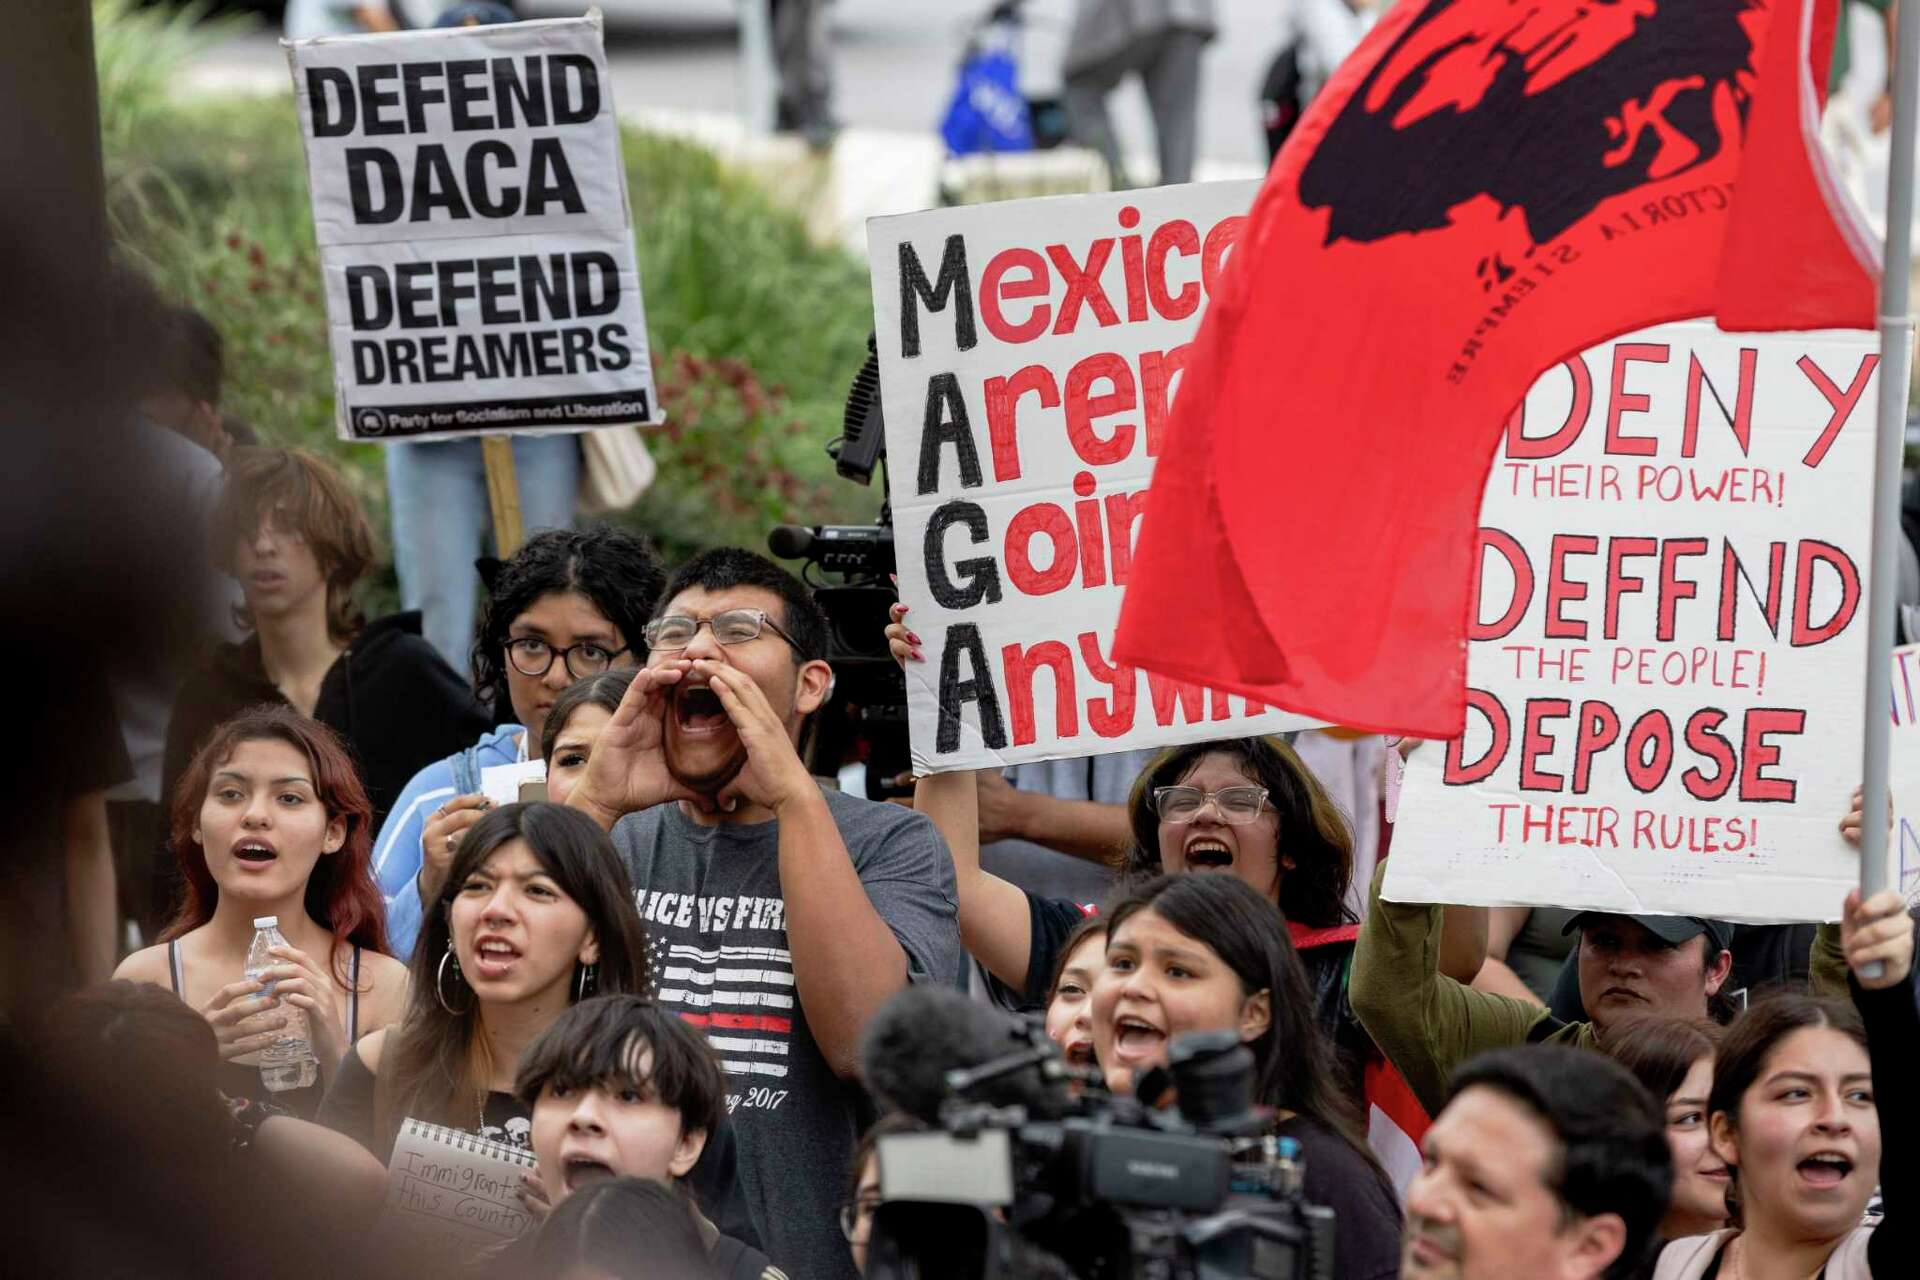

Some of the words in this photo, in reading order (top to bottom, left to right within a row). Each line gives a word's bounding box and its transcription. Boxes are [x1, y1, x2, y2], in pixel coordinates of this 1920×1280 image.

[306, 54, 600, 138] DEFEND
[345, 137, 587, 225] DACA
[346, 251, 620, 331] DEFEND
[352, 323, 631, 386] DREAMERS
[388, 412, 429, 430] Party
[431, 410, 456, 425] for
[456, 404, 531, 423] Socialism
[533, 403, 562, 419] and
[564, 400, 643, 418] Liberation
[1505, 343, 1880, 468] DENY
[1504, 463, 1622, 499] THEIR
[1638, 466, 1786, 507] POWER!
[1503, 646, 1585, 682] THE
[1612, 647, 1767, 695] PEOPLE!
[1443, 687, 1806, 803] DEPOSE
[1489, 803, 1618, 848] THEIR
[1632, 810, 1760, 858] RULES!
[698, 896, 734, 933] VS
[732, 895, 787, 931] FIR
[742, 1087, 789, 1110] 2017
